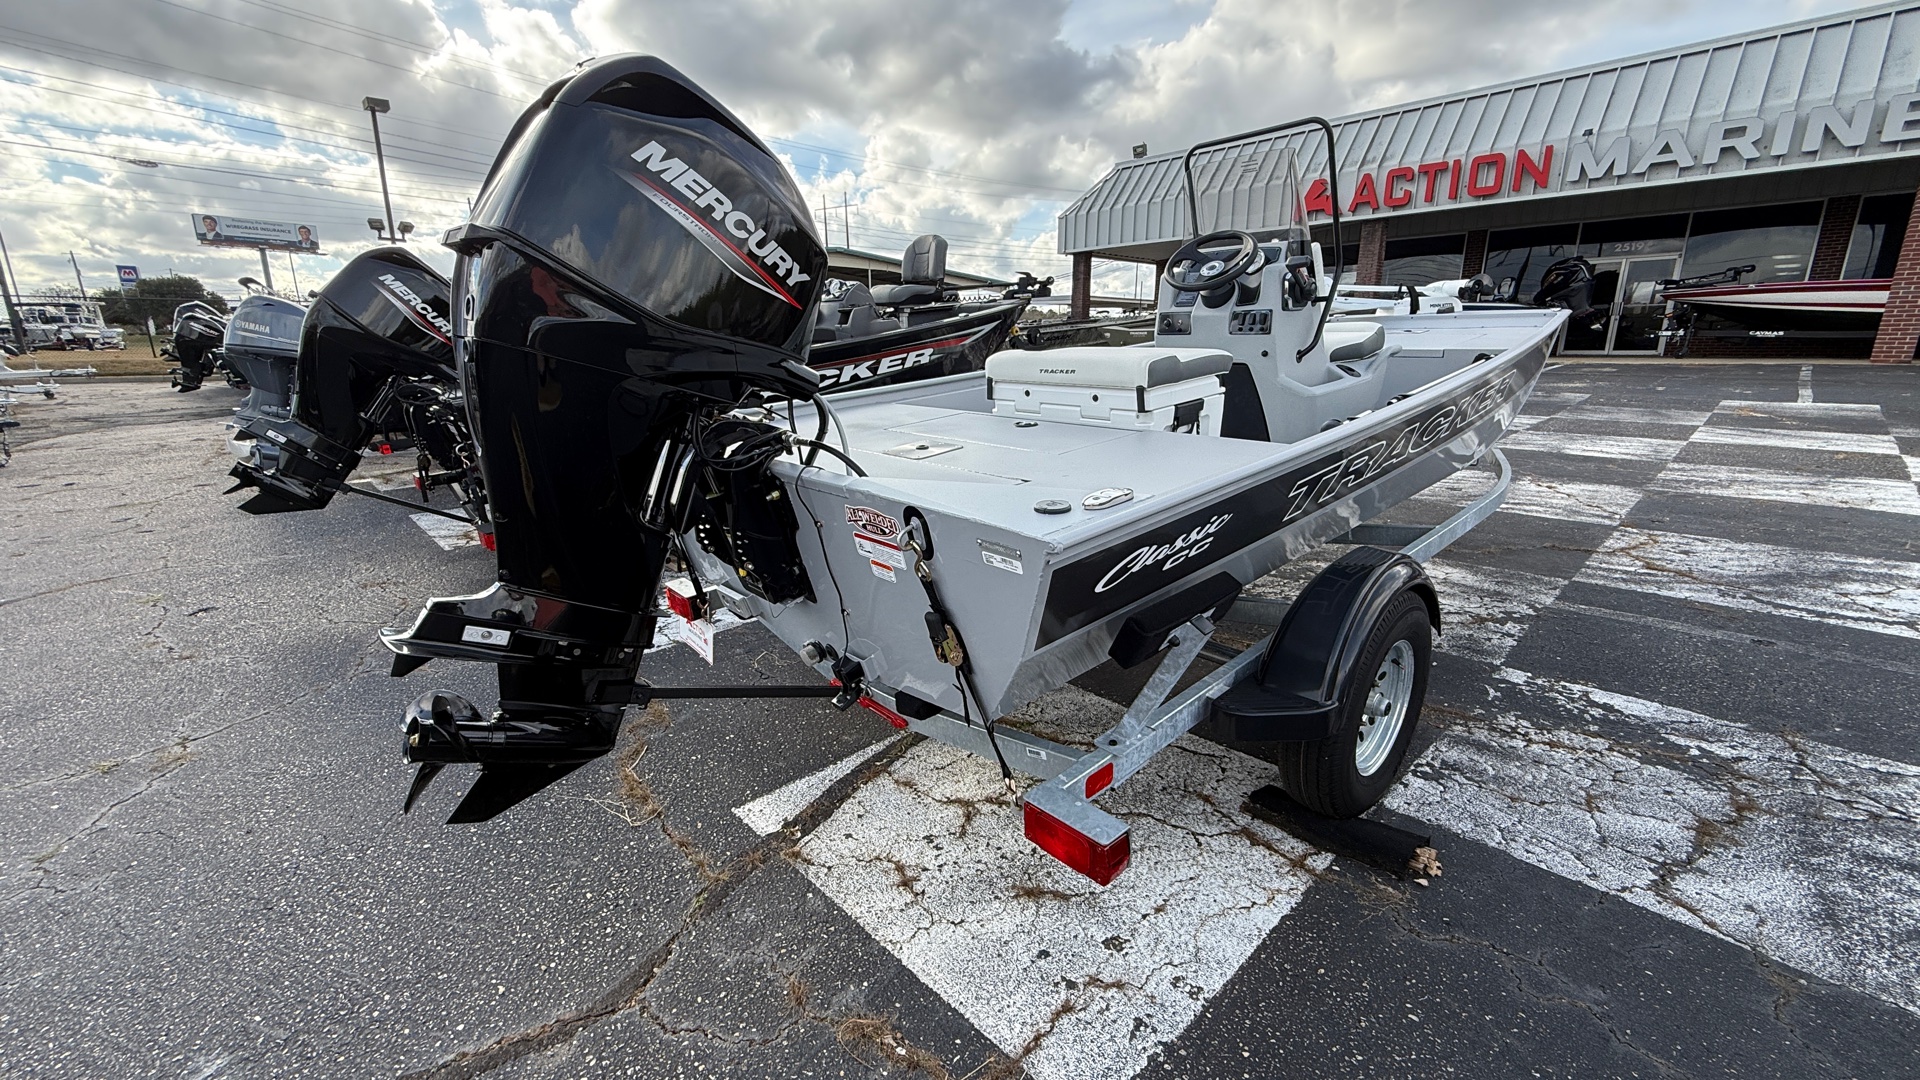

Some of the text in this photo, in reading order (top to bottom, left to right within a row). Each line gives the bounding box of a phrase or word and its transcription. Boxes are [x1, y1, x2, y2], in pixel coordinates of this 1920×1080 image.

[1348, 92, 1920, 213] ACTION MARINE
[260, 226, 291, 234] INSURANCE
[631, 140, 811, 287] MERCURY
[652, 191, 720, 246] FOURSTROKE
[1614, 242, 1645, 253] 2519
[241, 322, 270, 334] YAMAHA
[818, 347, 934, 389] CKER
[1282, 369, 1517, 523] TRACKER
[1094, 513, 1234, 593] Classic
[1162, 536, 1214, 571] CC
